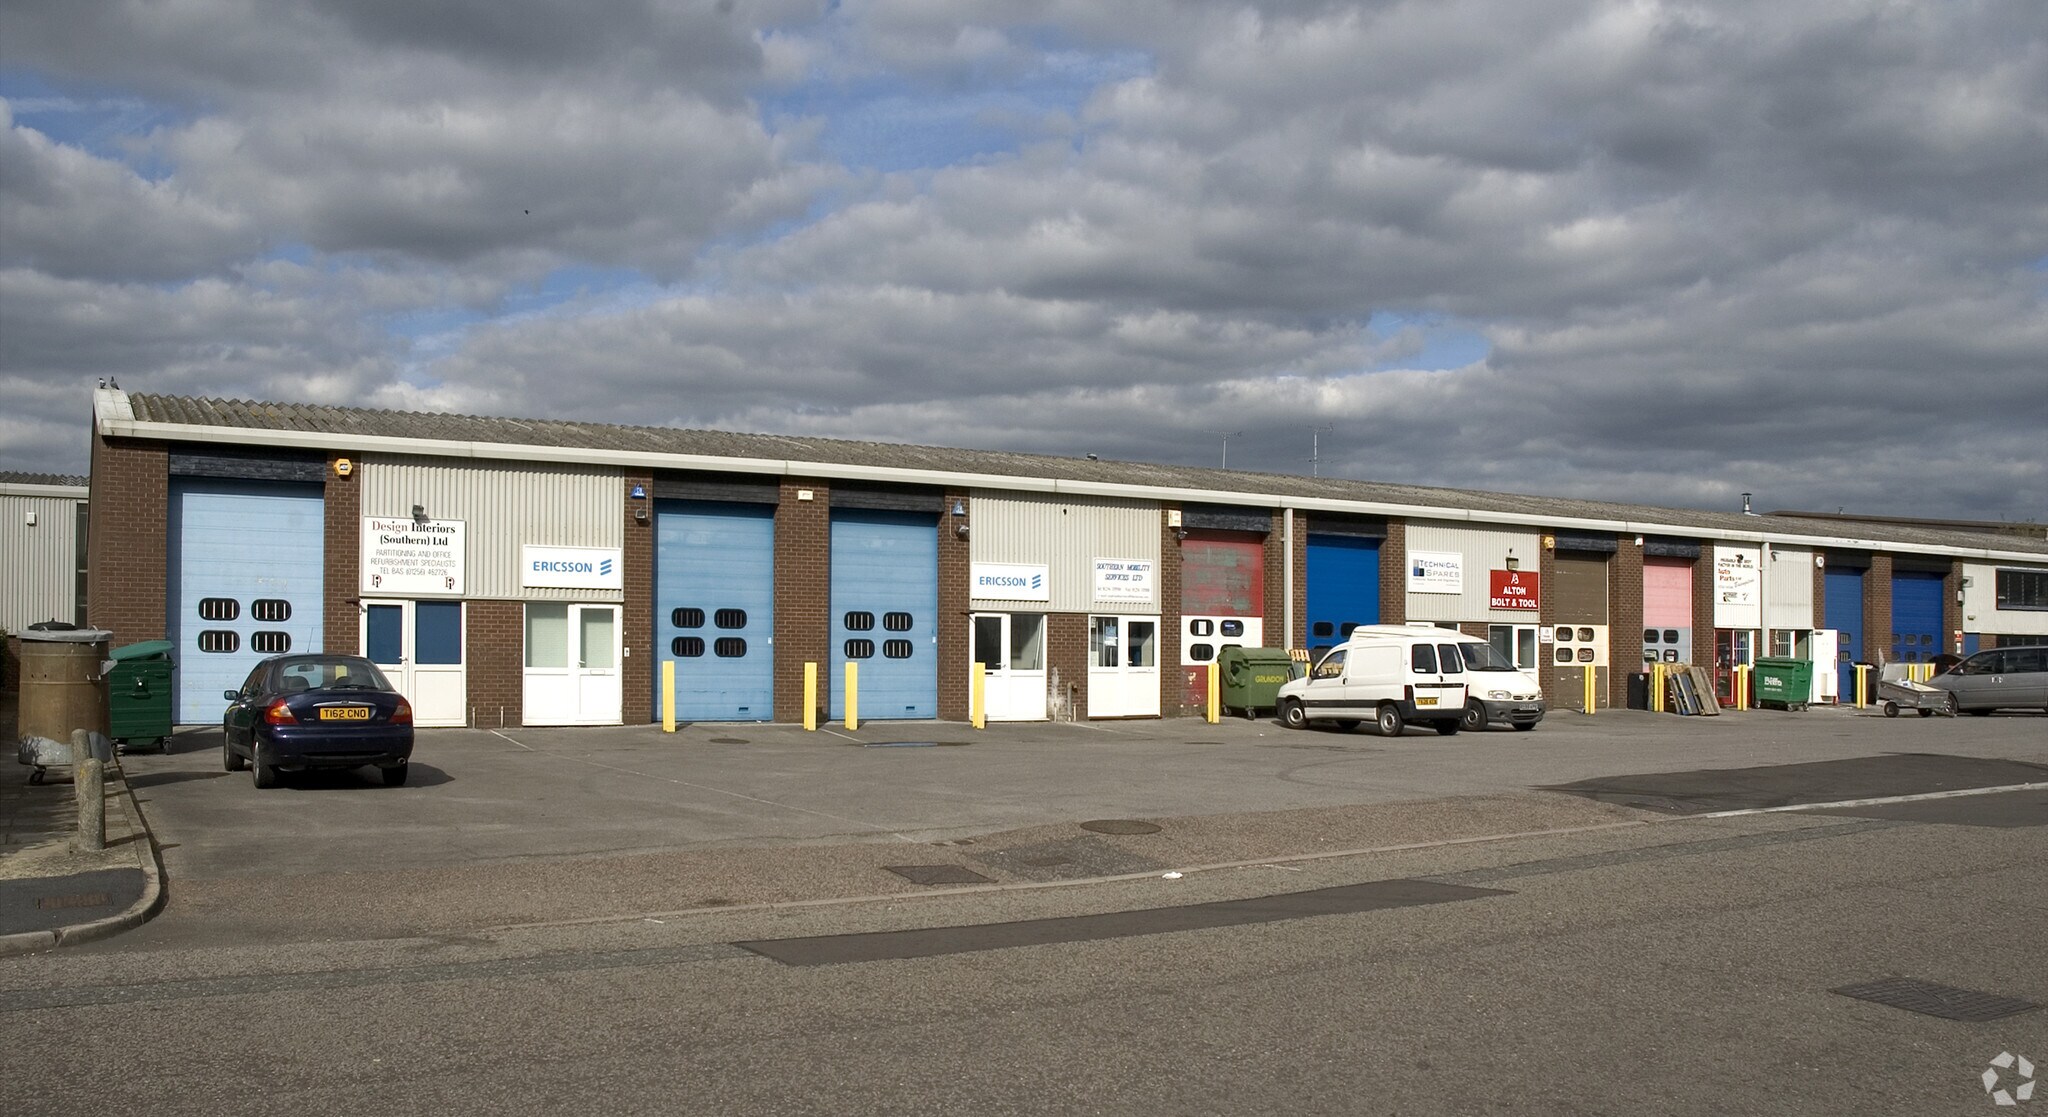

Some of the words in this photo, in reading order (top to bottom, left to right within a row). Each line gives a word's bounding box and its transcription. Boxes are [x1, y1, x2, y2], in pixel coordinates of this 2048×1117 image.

[372, 520, 408, 534] Design
[411, 522, 456, 534] Interiors
[380, 534, 430, 546] (Southern)
[433, 536, 448, 546] Ltd
[376, 549, 416, 557] PARTITIONING
[418, 550, 431, 558] AND
[433, 551, 451, 559] OFFICE
[370, 557, 418, 566] REFURBISHMENT
[421, 559, 456, 568] SPECIALISTS
[533, 561, 593, 573] ERICSSON
[1426, 569, 1460, 578] SPARES
[979, 576, 1026, 587] ERICSSON
[1503, 586, 1527, 596] ALTON
[1491, 598, 1510, 607] BOLT
[1511, 598, 1517, 607] &
[1518, 599, 1538, 608] TOOL
[324, 709, 345, 718] T162
[347, 709, 367, 718] CNO
